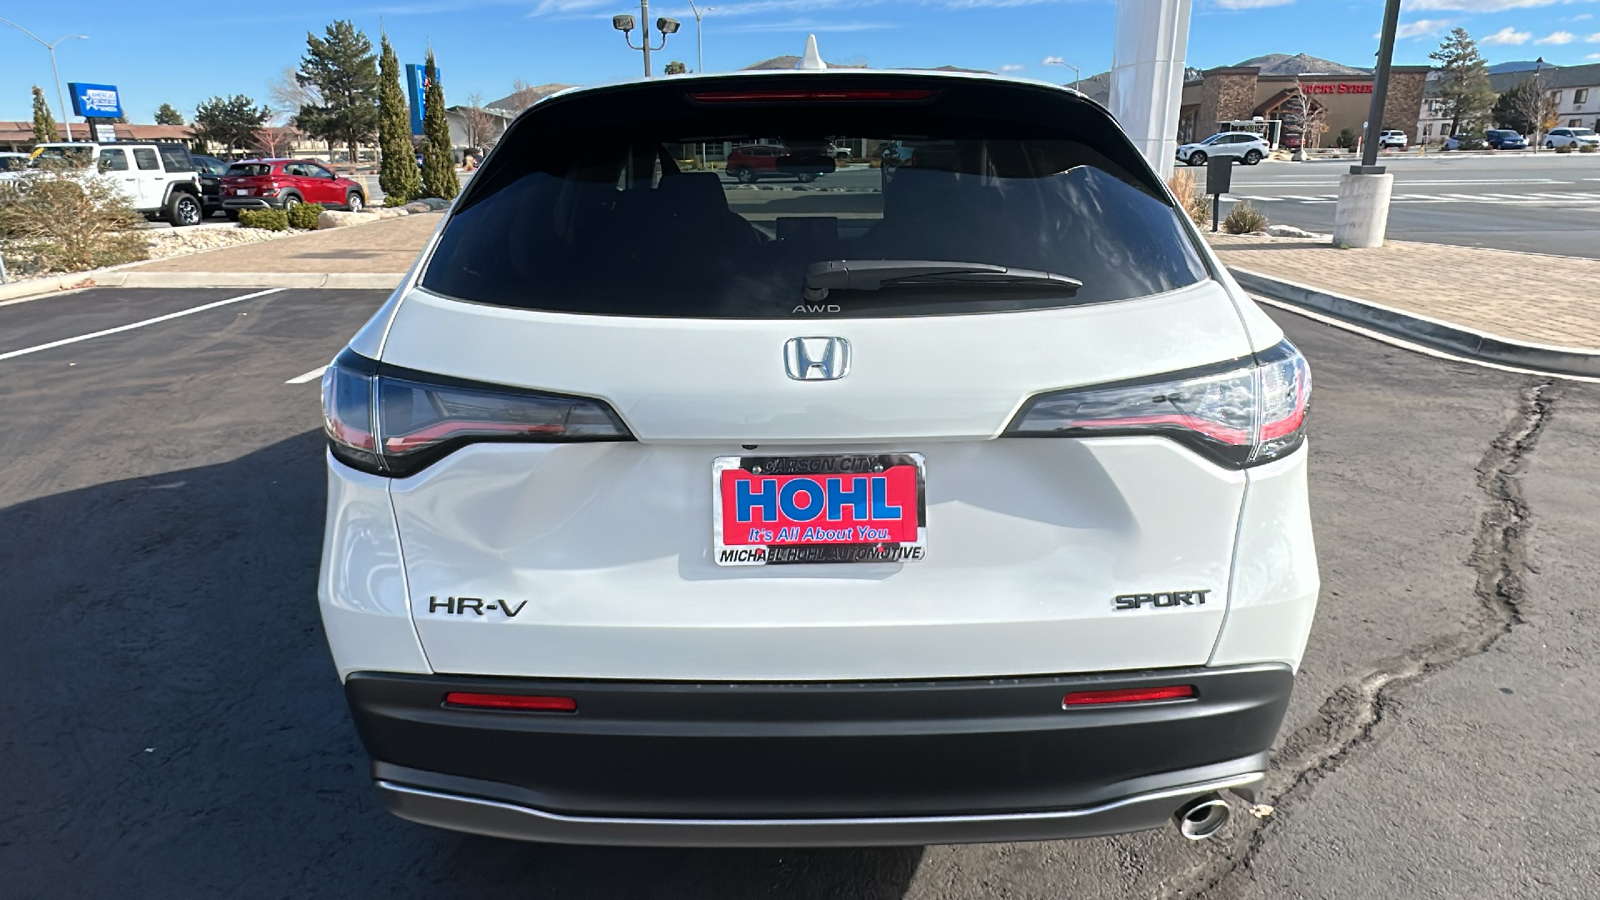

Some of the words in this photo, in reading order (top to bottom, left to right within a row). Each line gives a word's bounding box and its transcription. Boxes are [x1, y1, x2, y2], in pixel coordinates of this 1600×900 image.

[792, 304, 841, 314] AWD
[766, 458, 837, 473] CARSON
[840, 457, 878, 472] CITY
[735, 477, 903, 522] HOHL
[748, 527, 774, 542] It's
[777, 527, 799, 542] All
[801, 526, 853, 541] About
[856, 525, 891, 540] You.
[720, 548, 783, 563] MICHAEL
[787, 548, 825, 562] HOHL
[826, 546, 921, 562] AUTOMOTIVE
[429, 596, 528, 617] HR-V
[1115, 589, 1211, 610] SPORT
